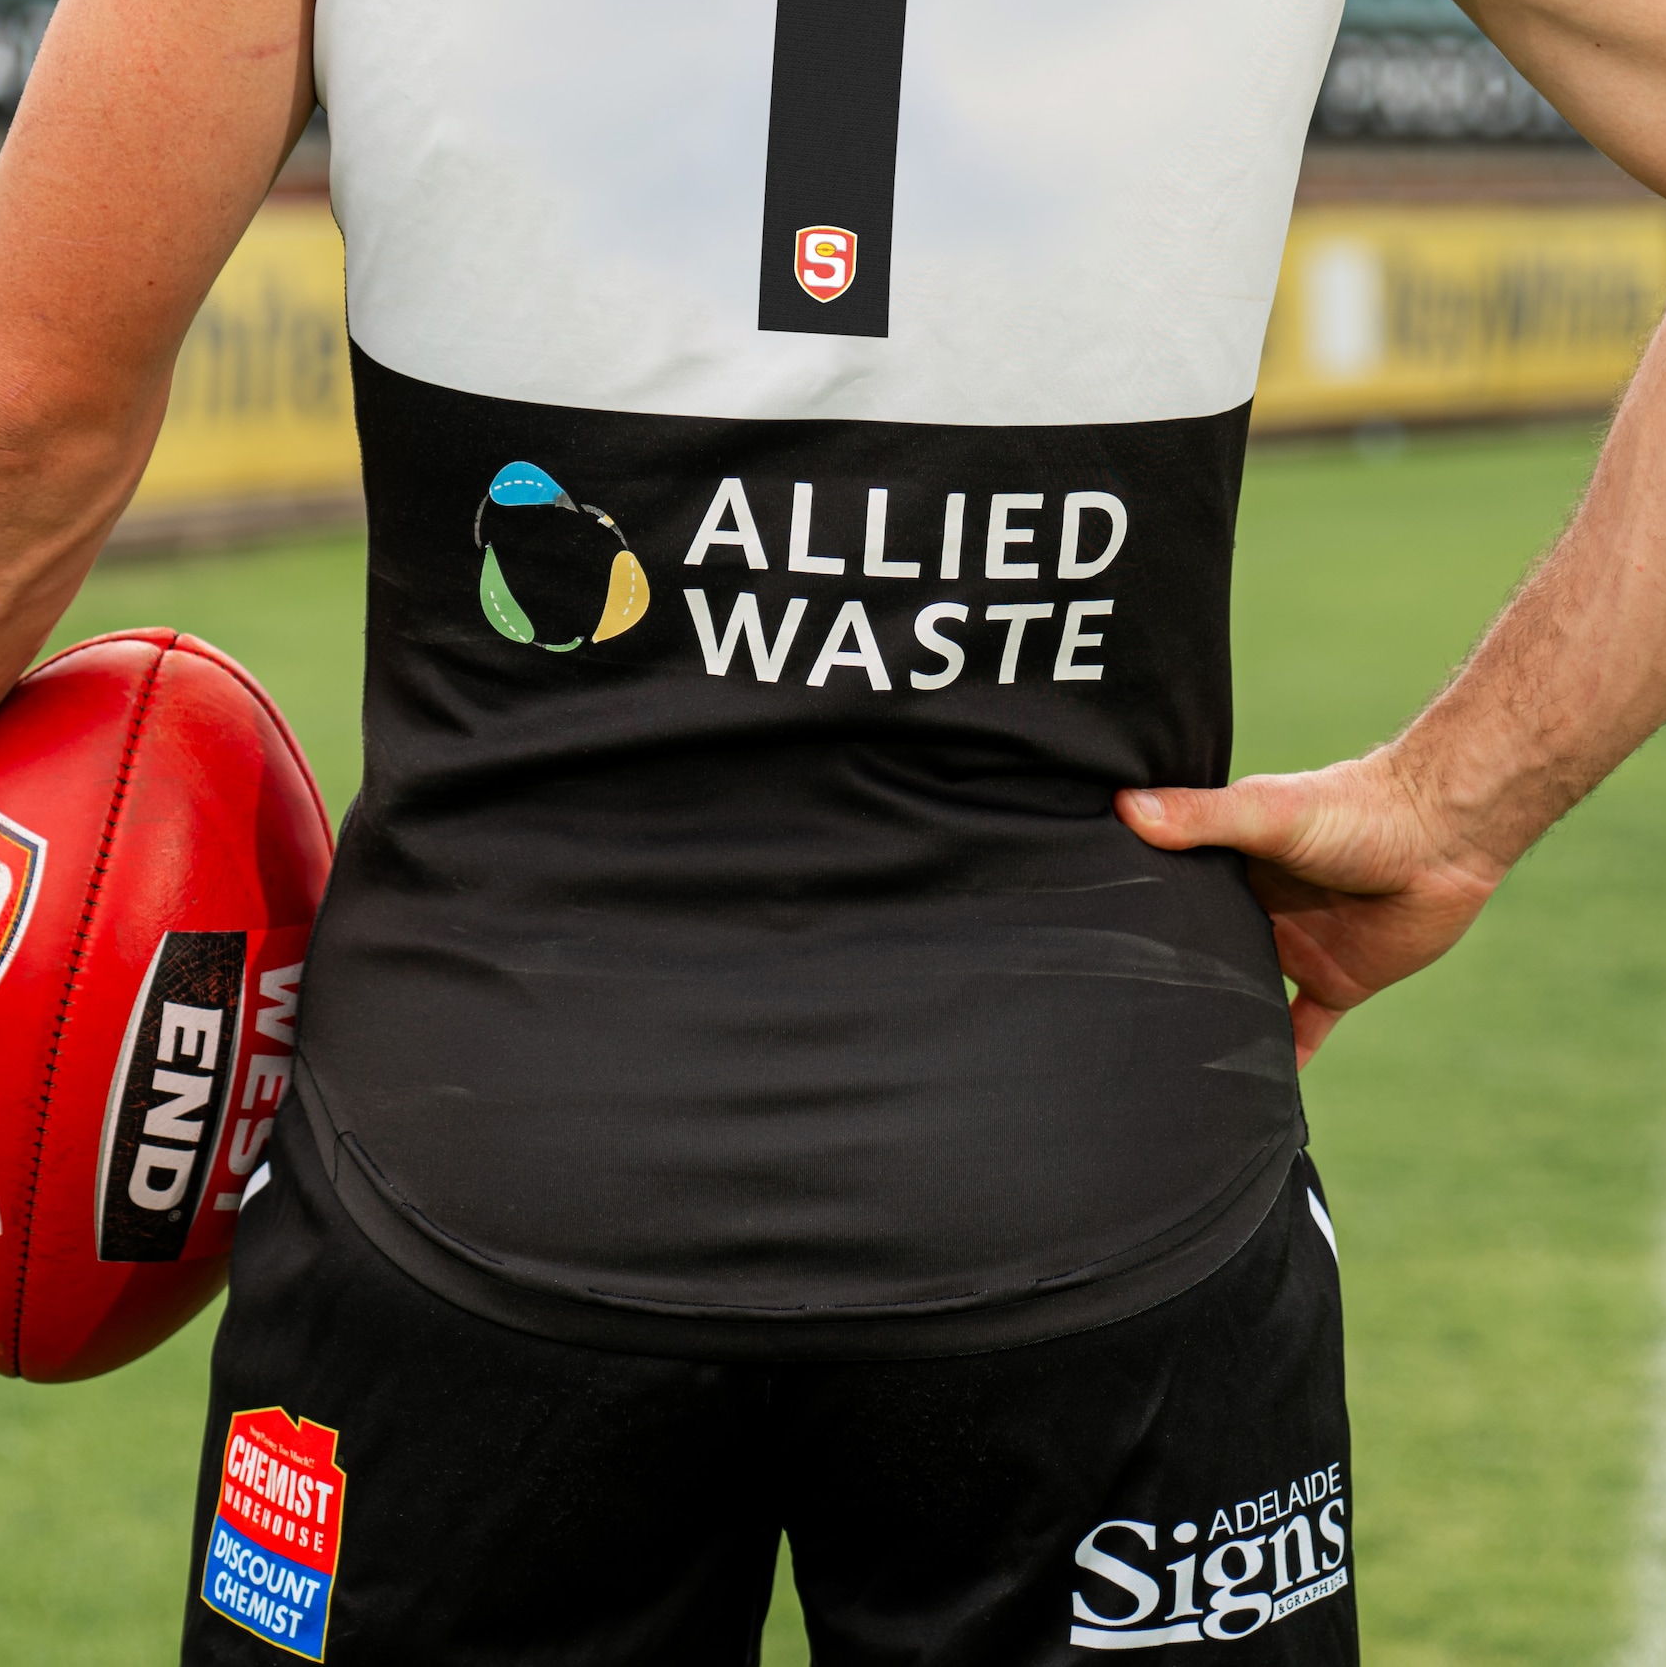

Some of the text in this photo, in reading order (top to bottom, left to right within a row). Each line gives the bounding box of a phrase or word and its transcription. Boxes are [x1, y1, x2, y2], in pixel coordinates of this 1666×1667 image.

[803, 233, 848, 289] S
[683, 477, 1128, 580] ALLIED
[683, 588, 1114, 691] WASTE
[128, 1001, 224, 1211] END
[224, 1481, 325, 1554] WAREHOUSE
[227, 1434, 334, 1525] CHEMIST
[1207, 1461, 1343, 1541] ADELAIDE
[213, 1529, 321, 1609] DISCOUNT
[214, 1571, 304, 1639] CHEMIST
[1071, 1497, 1346, 1641] Signs
